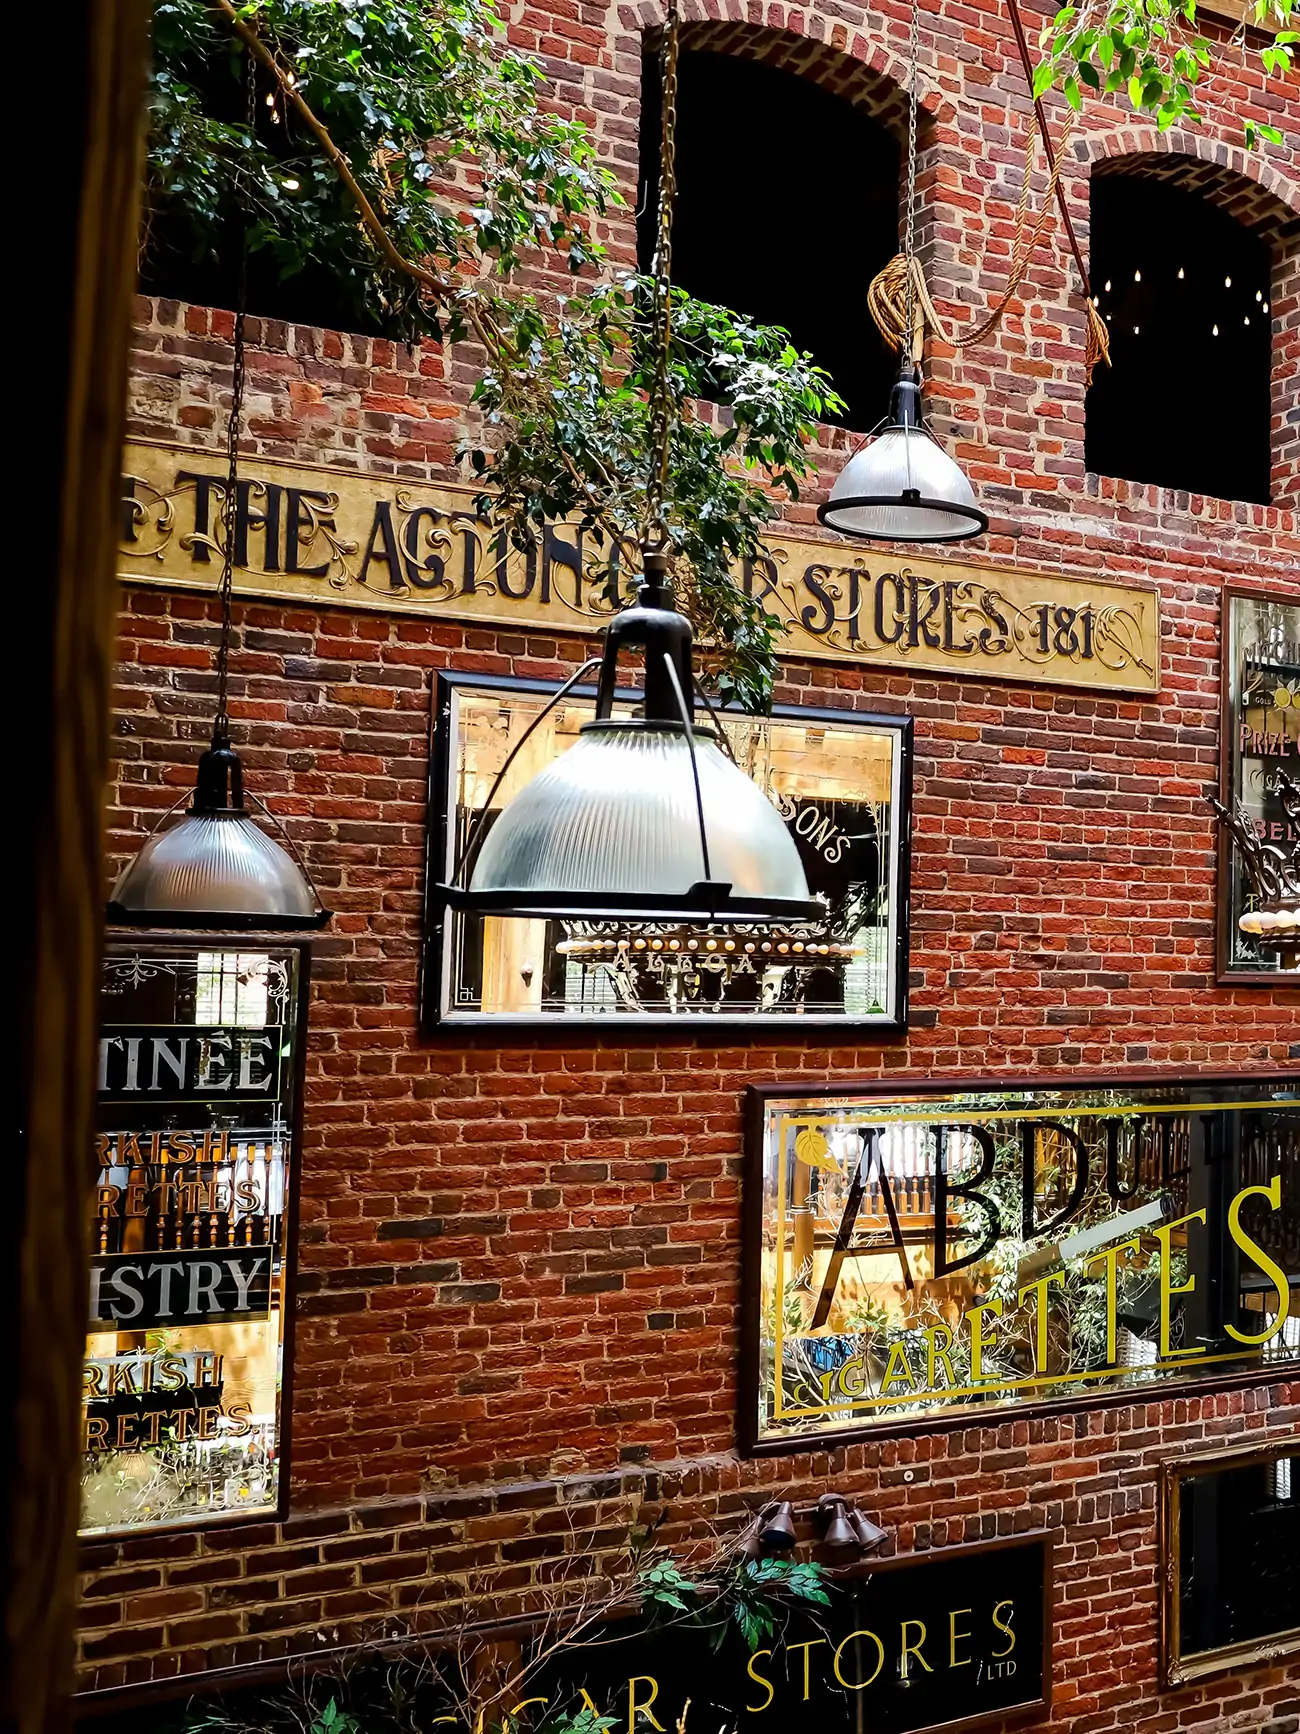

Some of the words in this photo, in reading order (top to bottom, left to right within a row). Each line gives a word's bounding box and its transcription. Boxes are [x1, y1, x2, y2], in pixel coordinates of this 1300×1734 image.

[174, 469, 338, 577] THE
[800, 562, 1010, 653] STORES
[1036, 604, 1095, 659] 181
[1255, 696, 1272, 705] GOLD
[1239, 723, 1292, 758] PRIZE
[793, 1175, 1291, 1403] CIGARETTES
[745, 1599, 1018, 1712] STORES
[985, 1659, 1018, 1682] LTD
